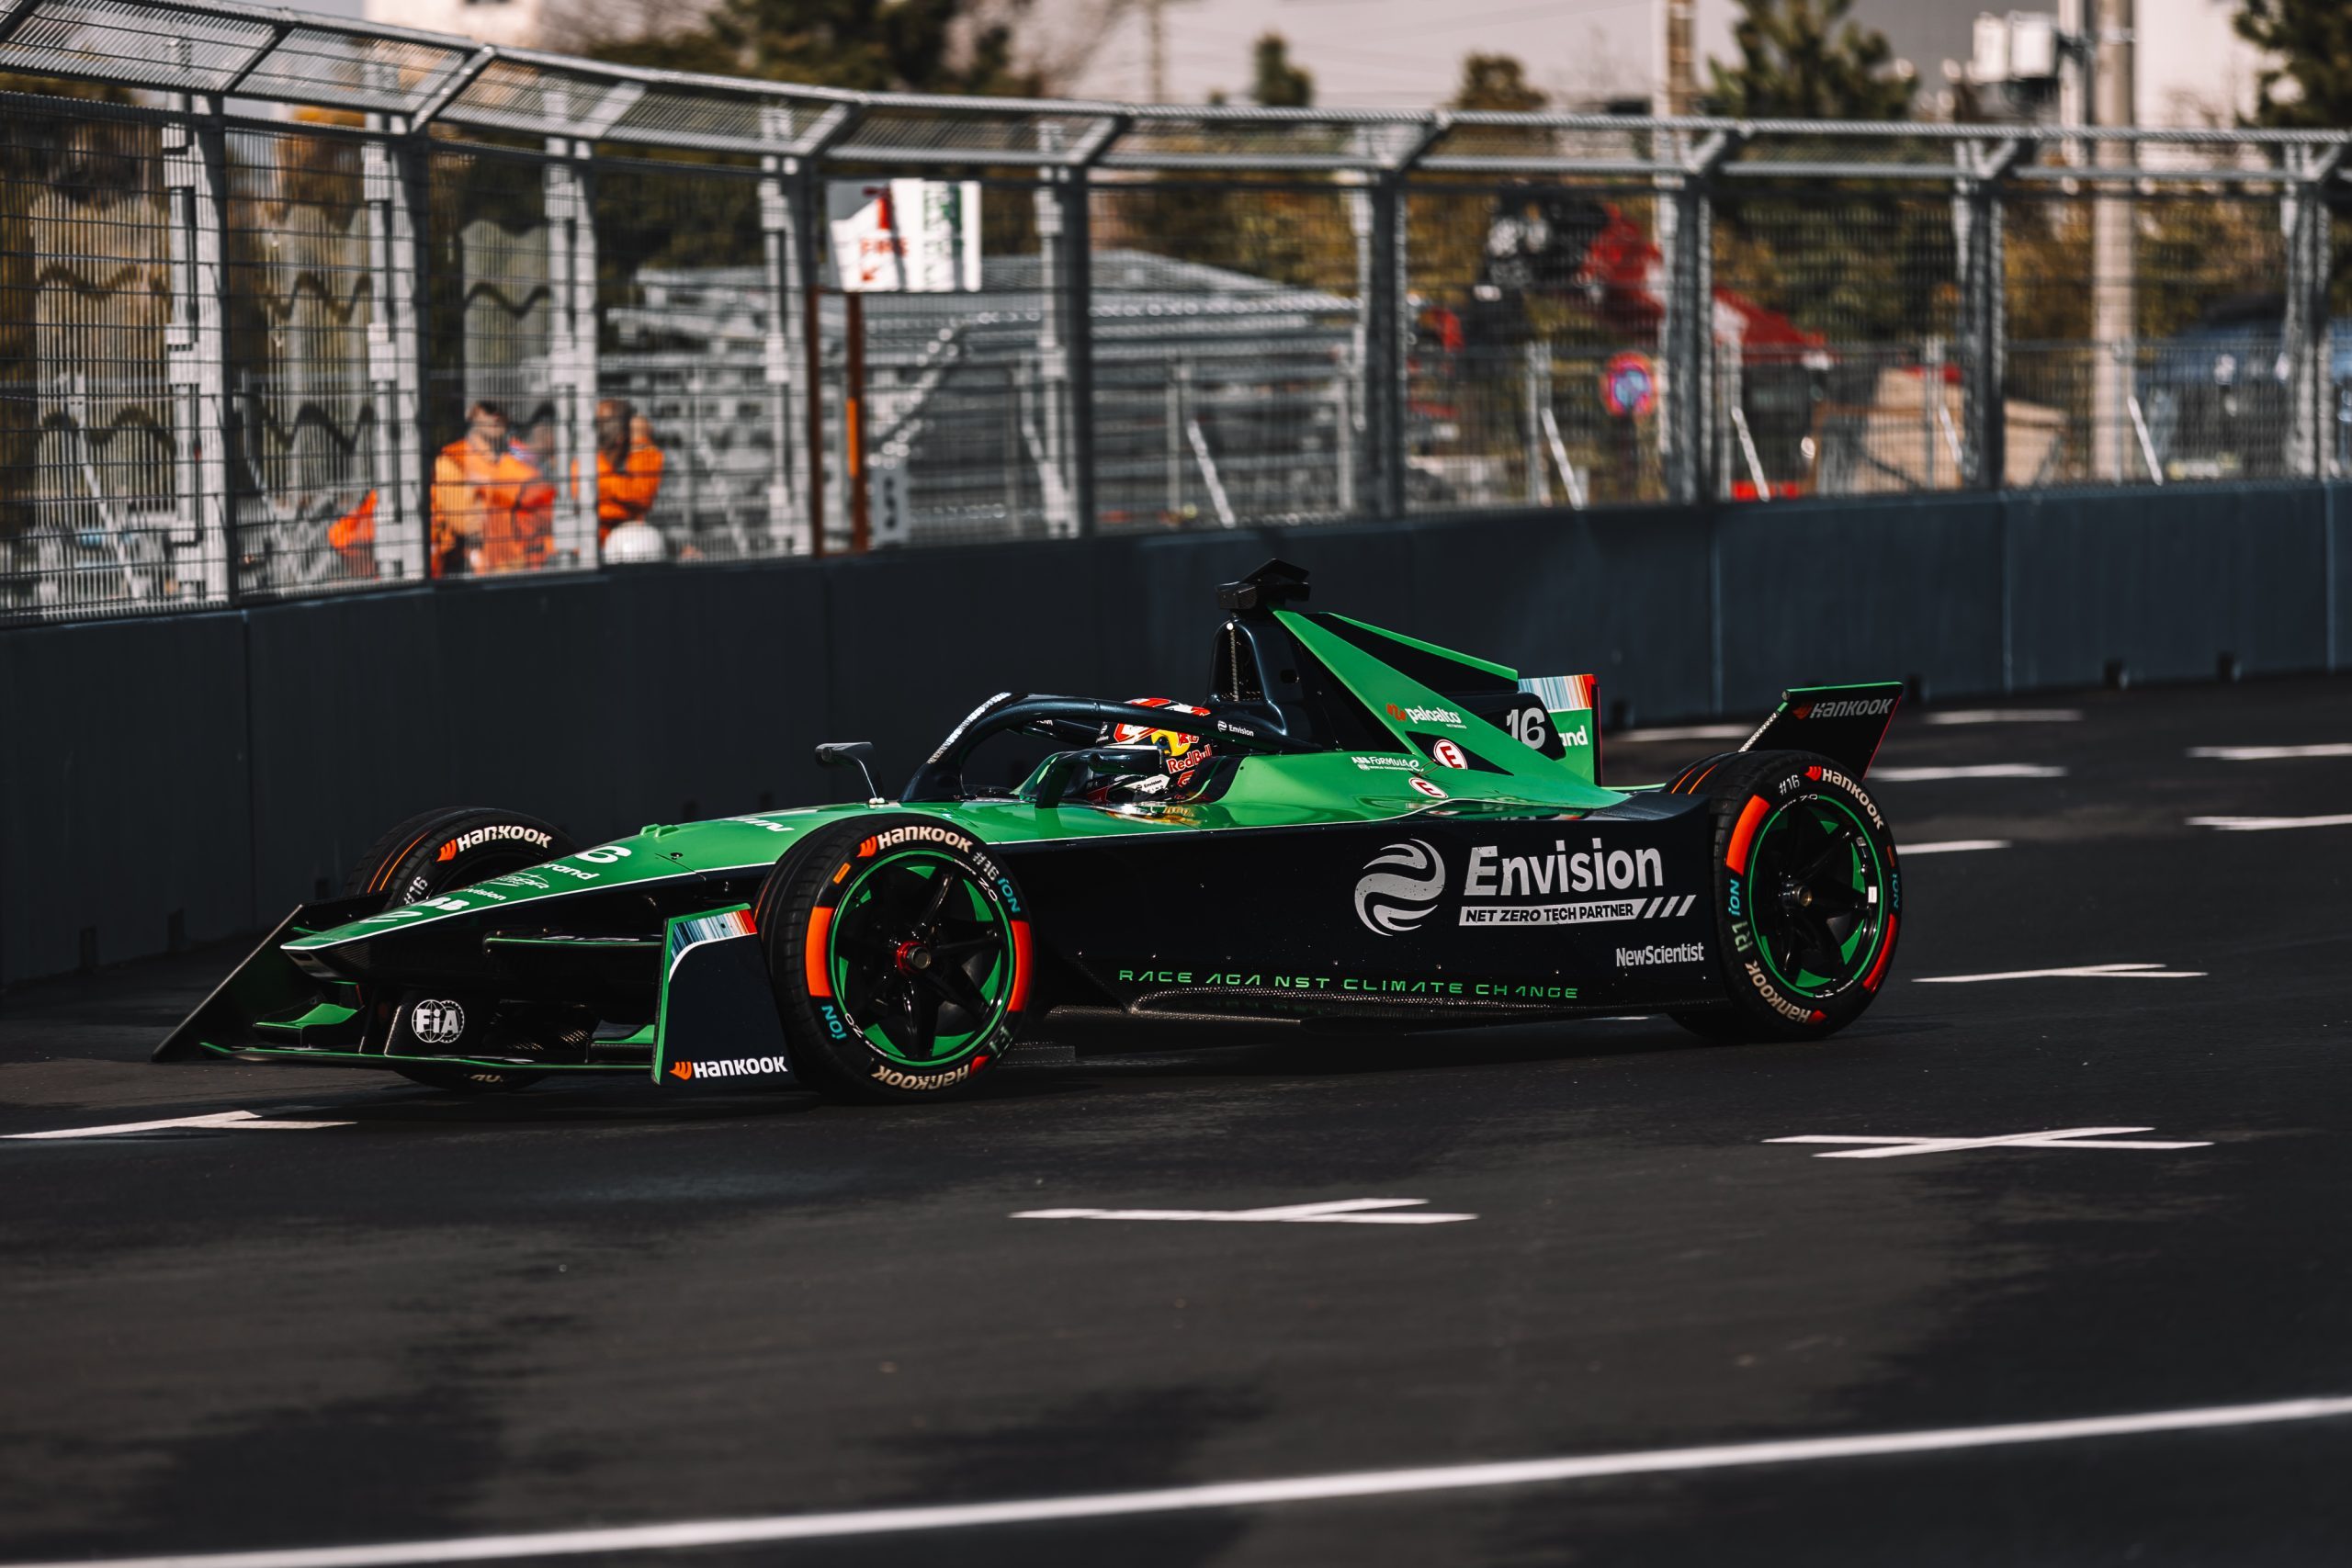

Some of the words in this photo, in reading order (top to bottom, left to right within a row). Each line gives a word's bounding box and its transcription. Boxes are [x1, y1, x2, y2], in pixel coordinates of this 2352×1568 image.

[1228, 725, 1254, 737] Envision
[1507, 707, 1545, 750] 16
[1779, 774, 1801, 796] #16
[575, 845, 632, 863] 6
[973, 852, 1000, 881] #16
[1464, 838, 1664, 896] Envision
[467, 887, 506, 901] vision
[1465, 909, 1498, 922] NET
[1499, 909, 1542, 922] ZERO
[1544, 907, 1577, 921] TECH
[1579, 903, 1634, 919] PARTNER
[1118, 969, 1193, 983] RACE
[1343, 978, 1464, 994] CLIMATE
